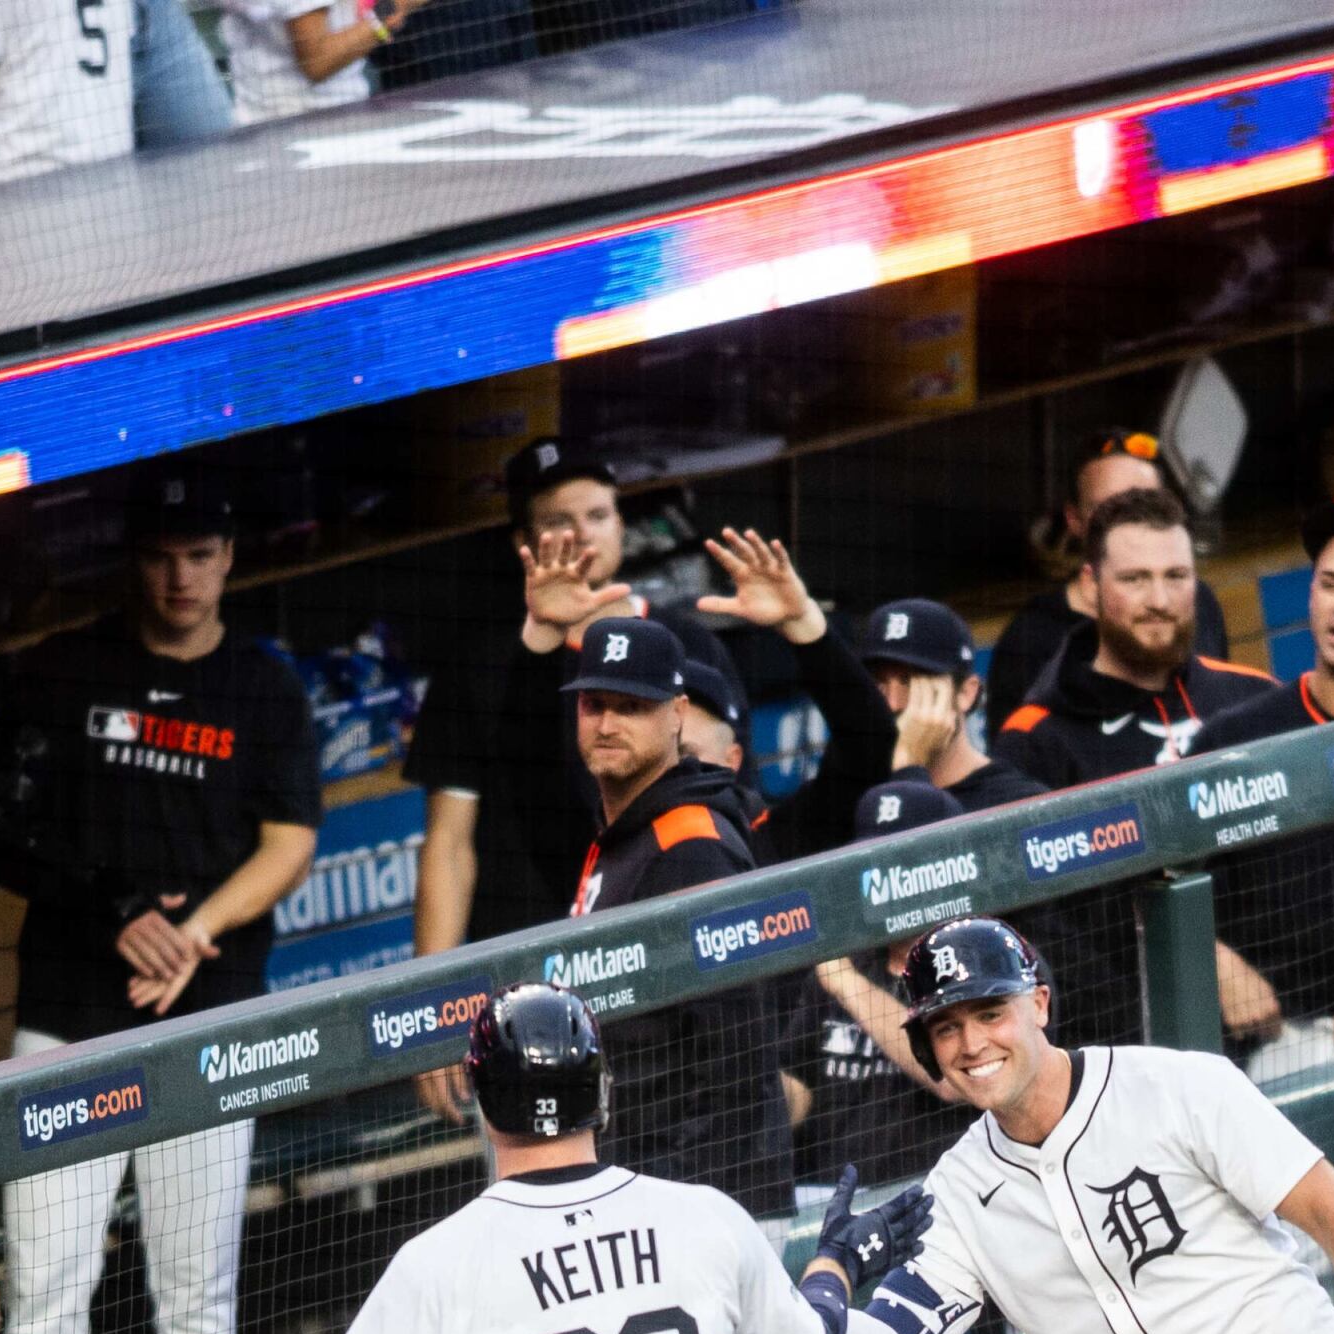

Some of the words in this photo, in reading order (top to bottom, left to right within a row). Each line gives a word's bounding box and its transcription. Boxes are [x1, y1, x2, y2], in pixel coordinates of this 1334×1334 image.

[75, 0, 108, 77] 5
[603, 632, 630, 664] D
[142, 712, 236, 760] TIGERS
[1216, 771, 1288, 814] McLaren
[1027, 818, 1140, 873] tigers.com
[1216, 822, 1253, 847] HEALTH
[1254, 814, 1279, 838] CARE
[889, 852, 978, 900] Karmanos
[695, 905, 811, 962] tigers.com
[885, 909, 923, 934] CANCER
[923, 896, 972, 922] INSTITUTE
[572, 942, 646, 987] McLaren
[930, 945, 958, 983] D
[609, 988, 636, 1010] CARE
[229, 1027, 319, 1078] Karmanos
[23, 1083, 142, 1142] tigers.com
[219, 1086, 260, 1112] CANCER
[260, 1072, 310, 1101] INSTITUTE
[535, 1098, 558, 1116] 33
[1085, 1166, 1188, 1286] D
[522, 1228, 661, 1310] KEITH
